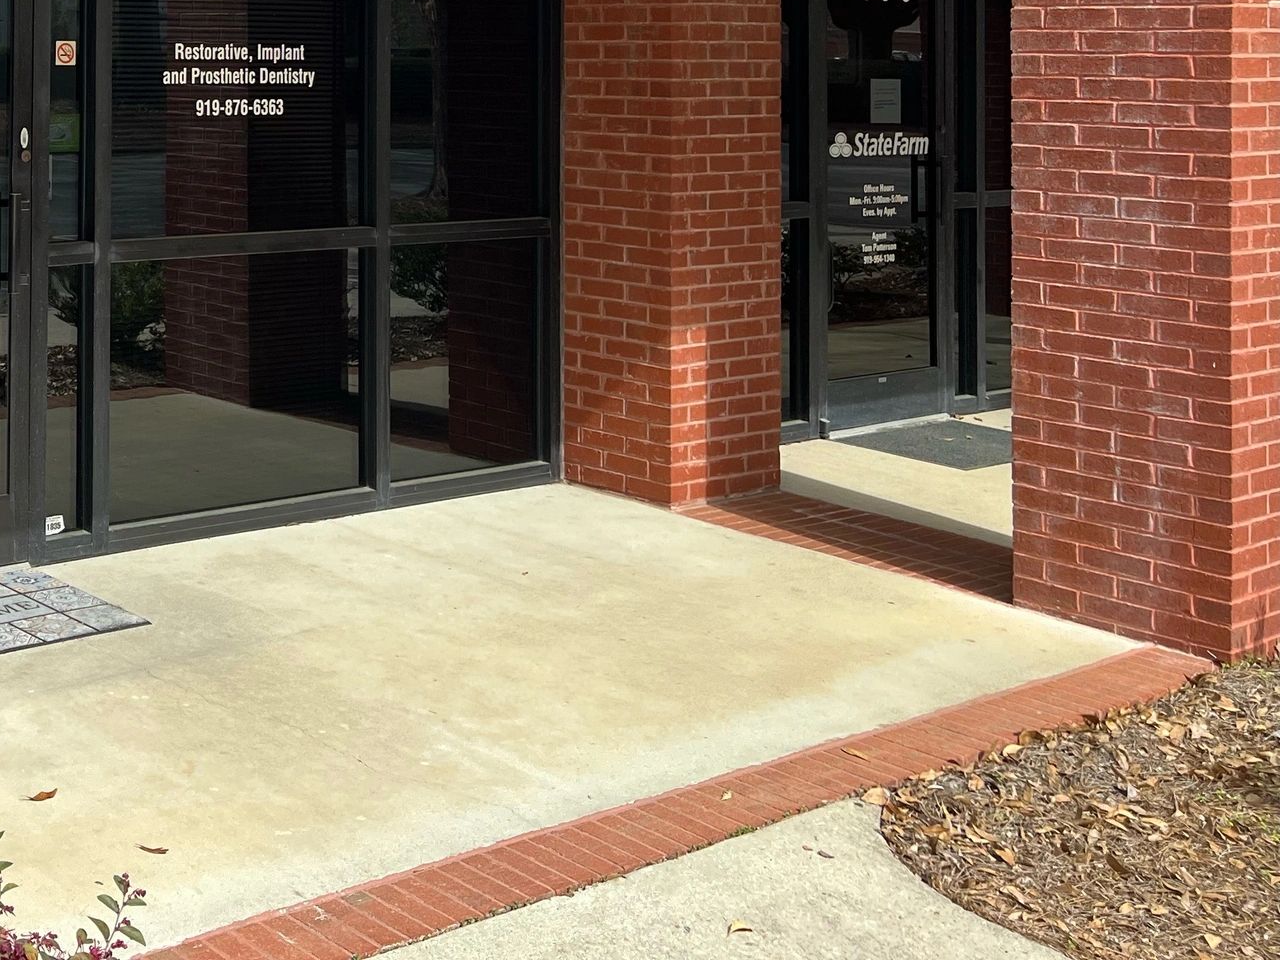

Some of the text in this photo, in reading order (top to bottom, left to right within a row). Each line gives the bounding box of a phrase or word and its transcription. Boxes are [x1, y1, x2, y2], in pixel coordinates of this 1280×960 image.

[174, 43, 305, 64] Restorative, Implant
[162, 66, 316, 88] and Prosthetic Dentistry
[195, 98, 284, 117] 919-876-6363
[863, 183, 895, 193] Office Hours
[876, 207, 883, 217] by
[871, 231, 887, 242] Agent
[861, 243, 873, 253] Tom
